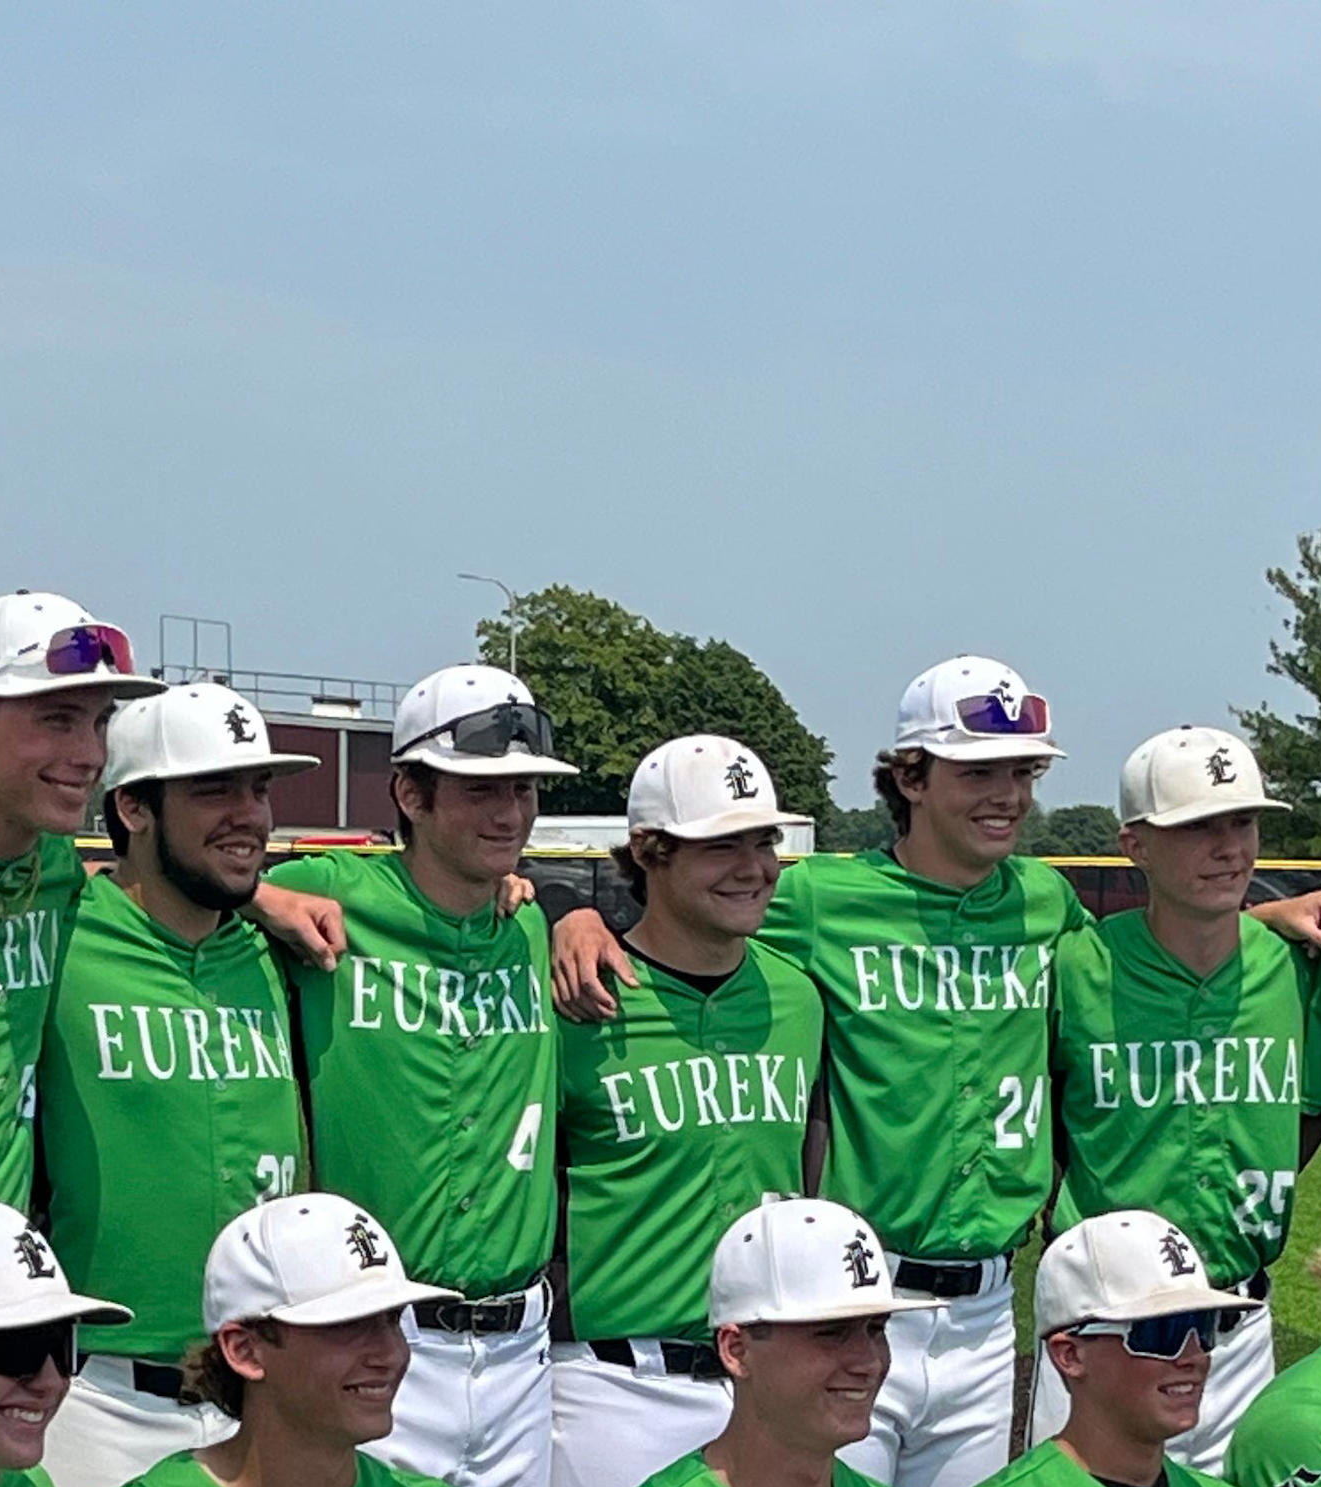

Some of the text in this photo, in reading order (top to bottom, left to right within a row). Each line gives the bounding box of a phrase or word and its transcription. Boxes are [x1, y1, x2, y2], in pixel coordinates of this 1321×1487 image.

[349, 956, 550, 1038] EUREKA
[849, 944, 1052, 1012] EUREKA
[600, 1054, 807, 1143] EUREKA
[1088, 1037, 1301, 1110] EUREKA
[506, 1103, 543, 1171] 4
[994, 1075, 1045, 1149] 24
[1235, 1169, 1295, 1241] 25
